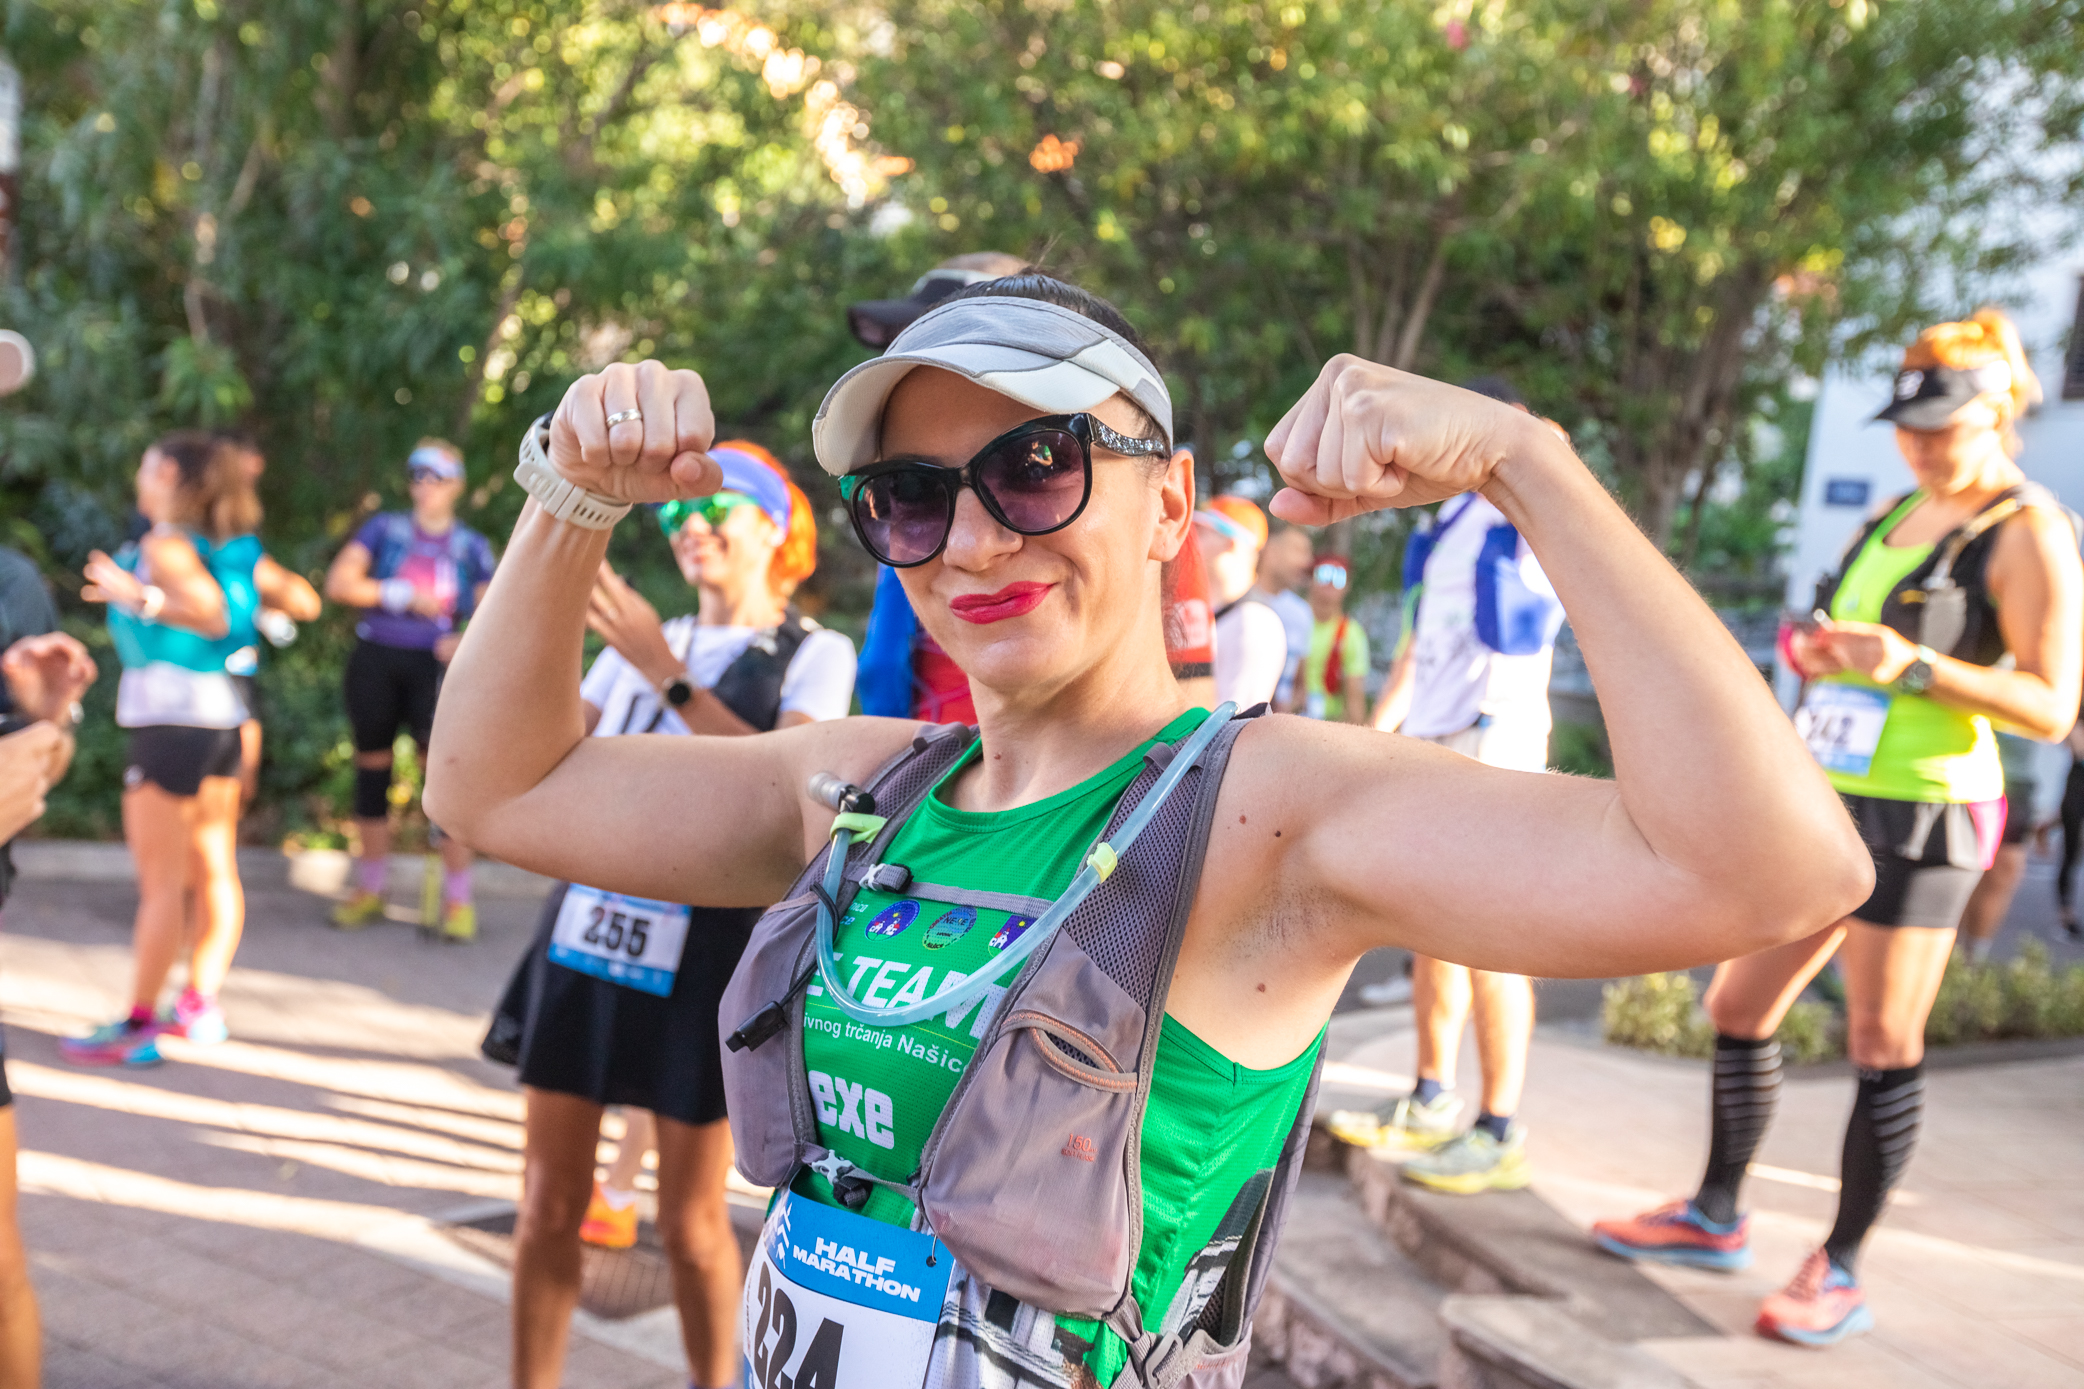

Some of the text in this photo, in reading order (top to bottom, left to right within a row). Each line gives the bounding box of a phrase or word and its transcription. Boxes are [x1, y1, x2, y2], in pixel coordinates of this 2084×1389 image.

[583, 905, 650, 957] 255
[846, 955, 1008, 1040] TEAM
[845, 1022, 893, 1049] trčanja
[897, 1034, 968, 1074] Našic
[808, 1070, 895, 1150] exe
[792, 1244, 921, 1303] MARATHON
[815, 1236, 896, 1276] HALF
[753, 1260, 845, 1389] 224
